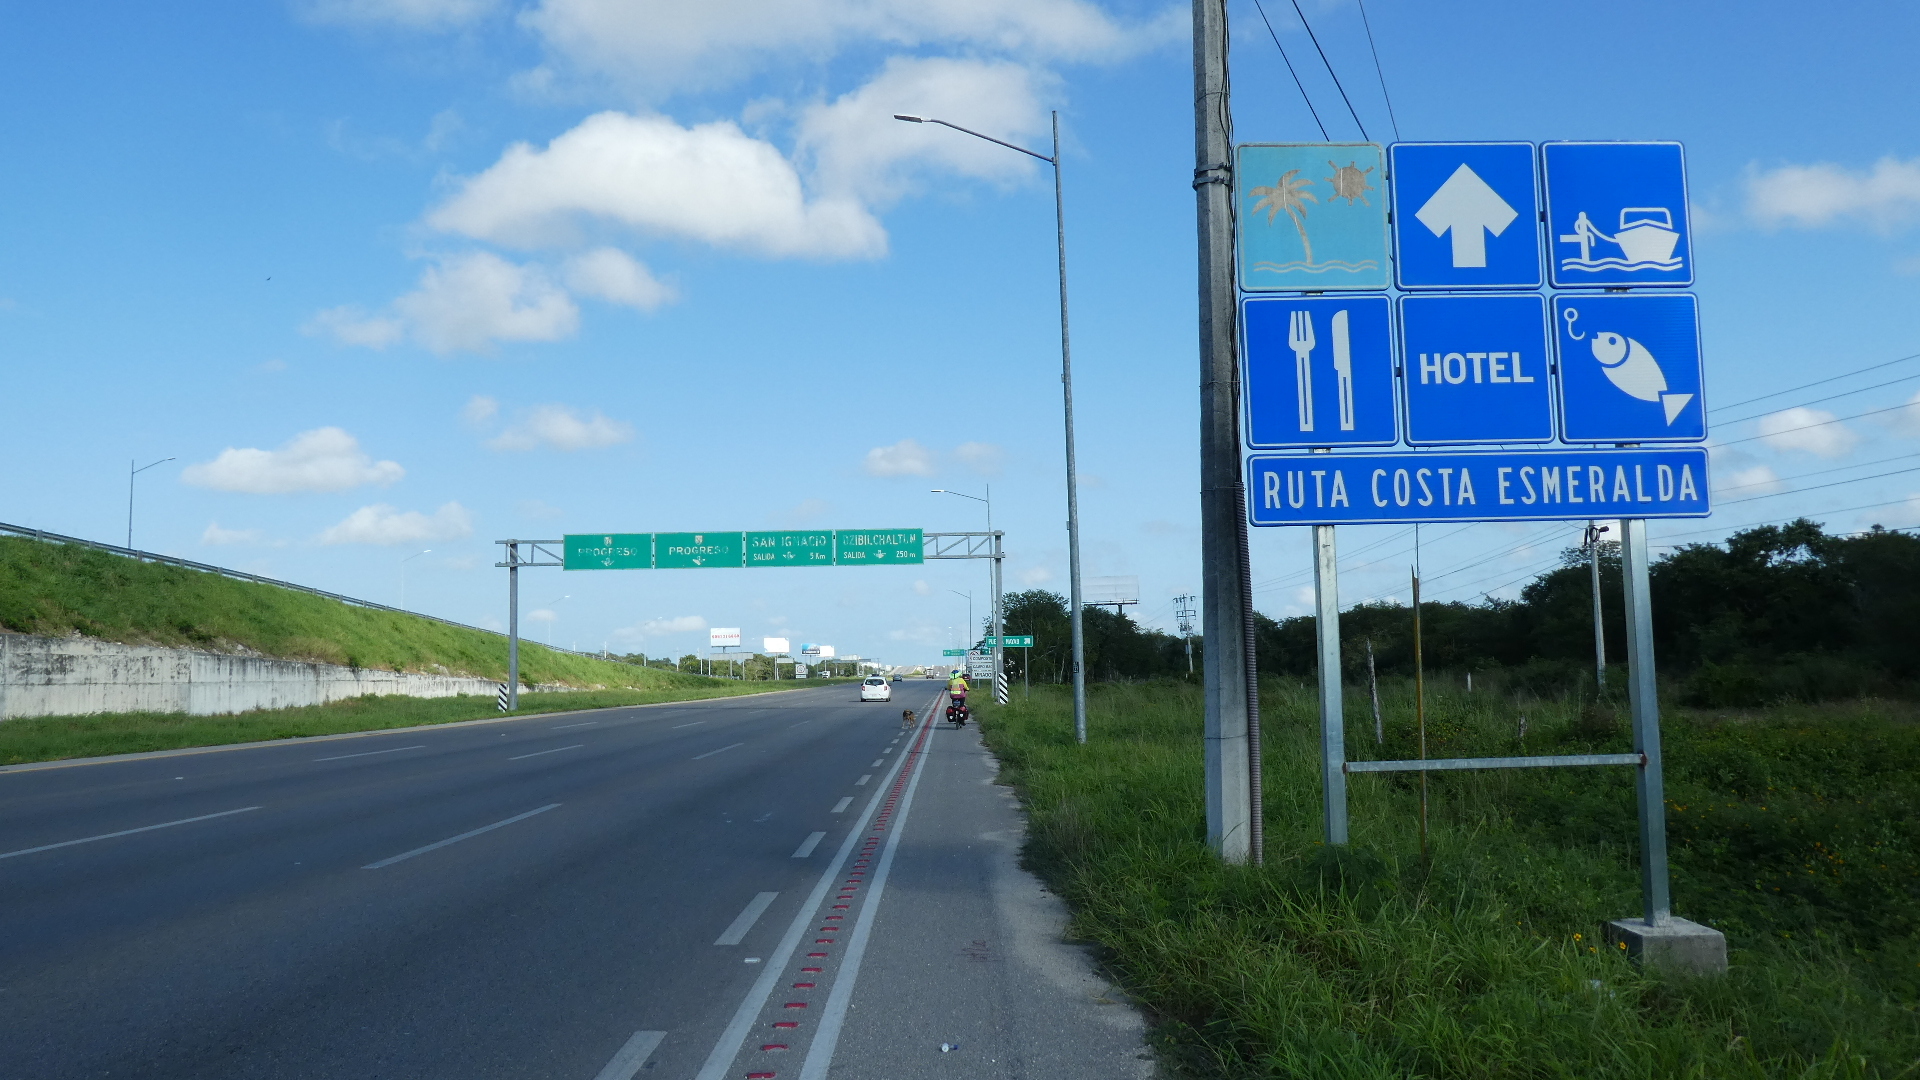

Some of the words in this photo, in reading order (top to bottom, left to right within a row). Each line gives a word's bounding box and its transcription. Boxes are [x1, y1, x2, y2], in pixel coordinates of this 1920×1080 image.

[1419, 351, 1534, 385] HOTEL
[1263, 469, 1350, 510] RUTA
[1371, 466, 1477, 508] COSTA
[1497, 463, 1698, 506] ESMERALDA
[752, 536, 776, 548] SAN
[669, 545, 730, 556] PROGRESO
[843, 551, 866, 559] SALIDA
[895, 550, 908, 558] 250
[753, 553, 775, 561] SALIDA
